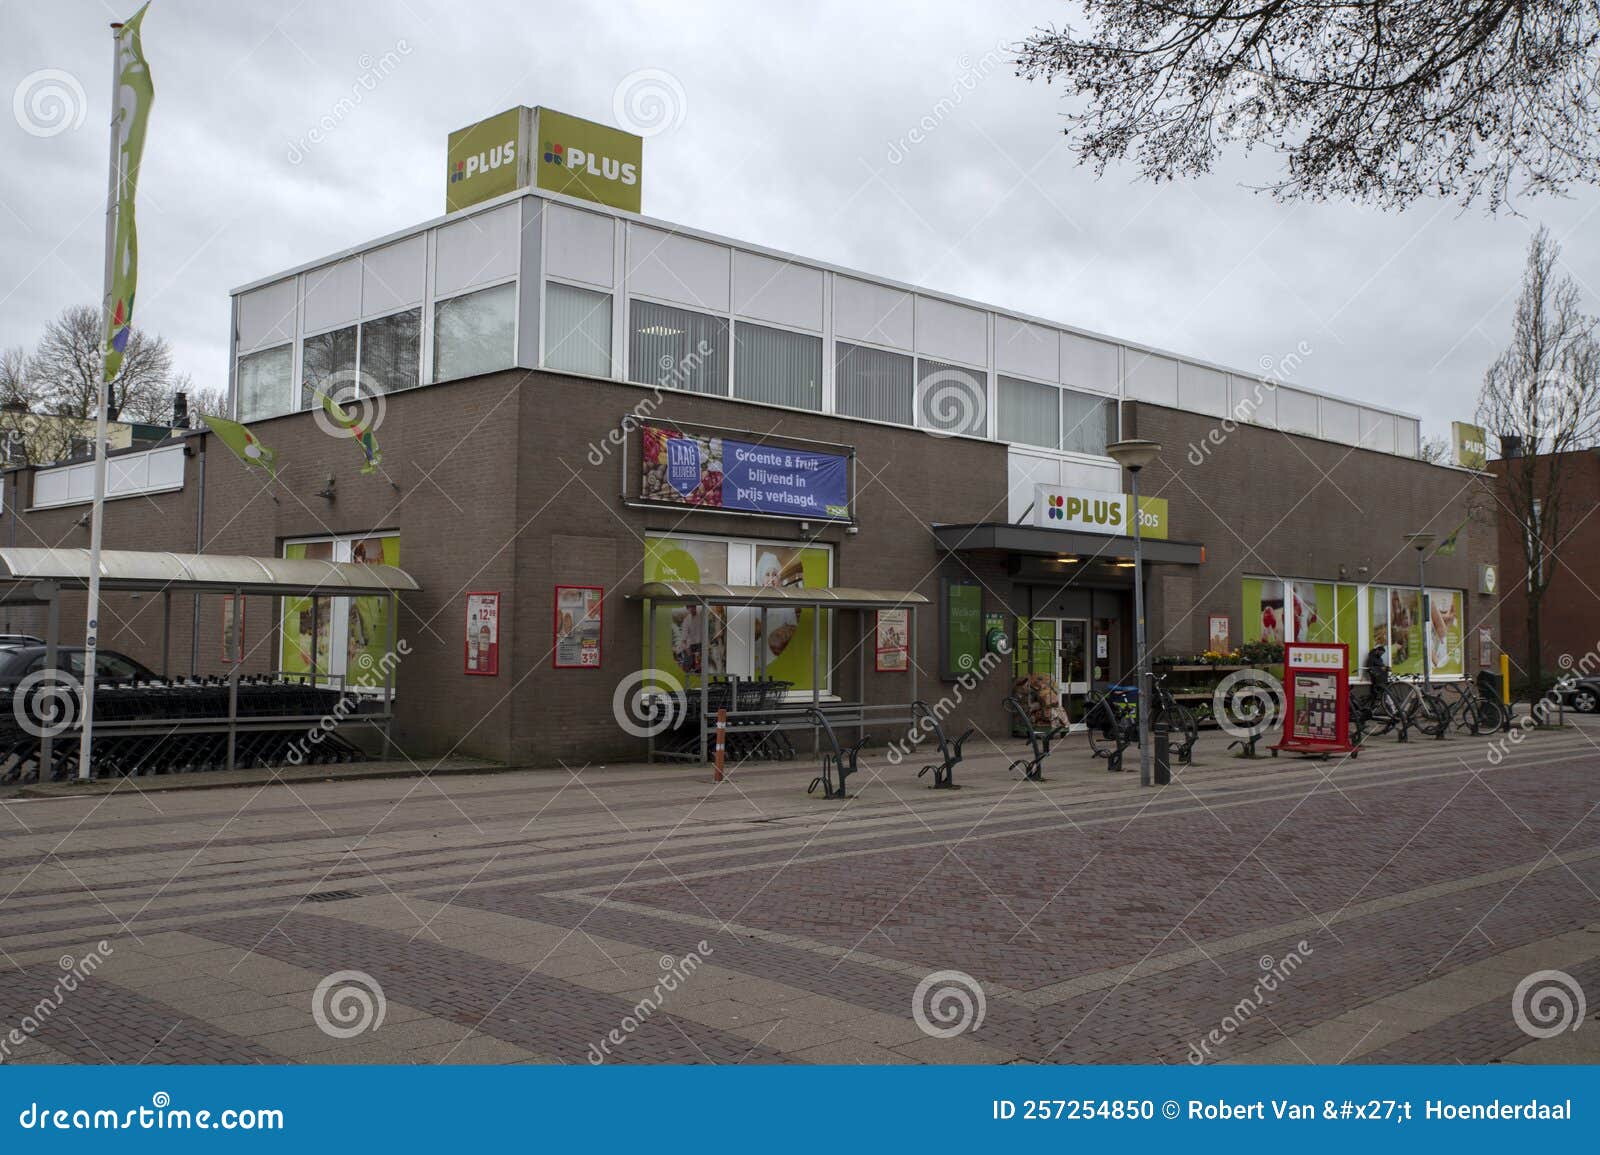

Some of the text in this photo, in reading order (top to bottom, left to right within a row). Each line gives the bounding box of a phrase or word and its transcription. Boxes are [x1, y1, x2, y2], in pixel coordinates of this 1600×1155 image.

[466, 140, 515, 179] PLUS
[567, 147, 637, 185] PLUS
[671, 445, 696, 466] LAAG
[735, 448, 819, 471] Groente & fruit
[748, 468, 806, 488] blijvend in
[736, 487, 818, 507] prijs verlaagd.
[1066, 496, 1122, 526] PLUS
[1303, 652, 1339, 664] PLUS
